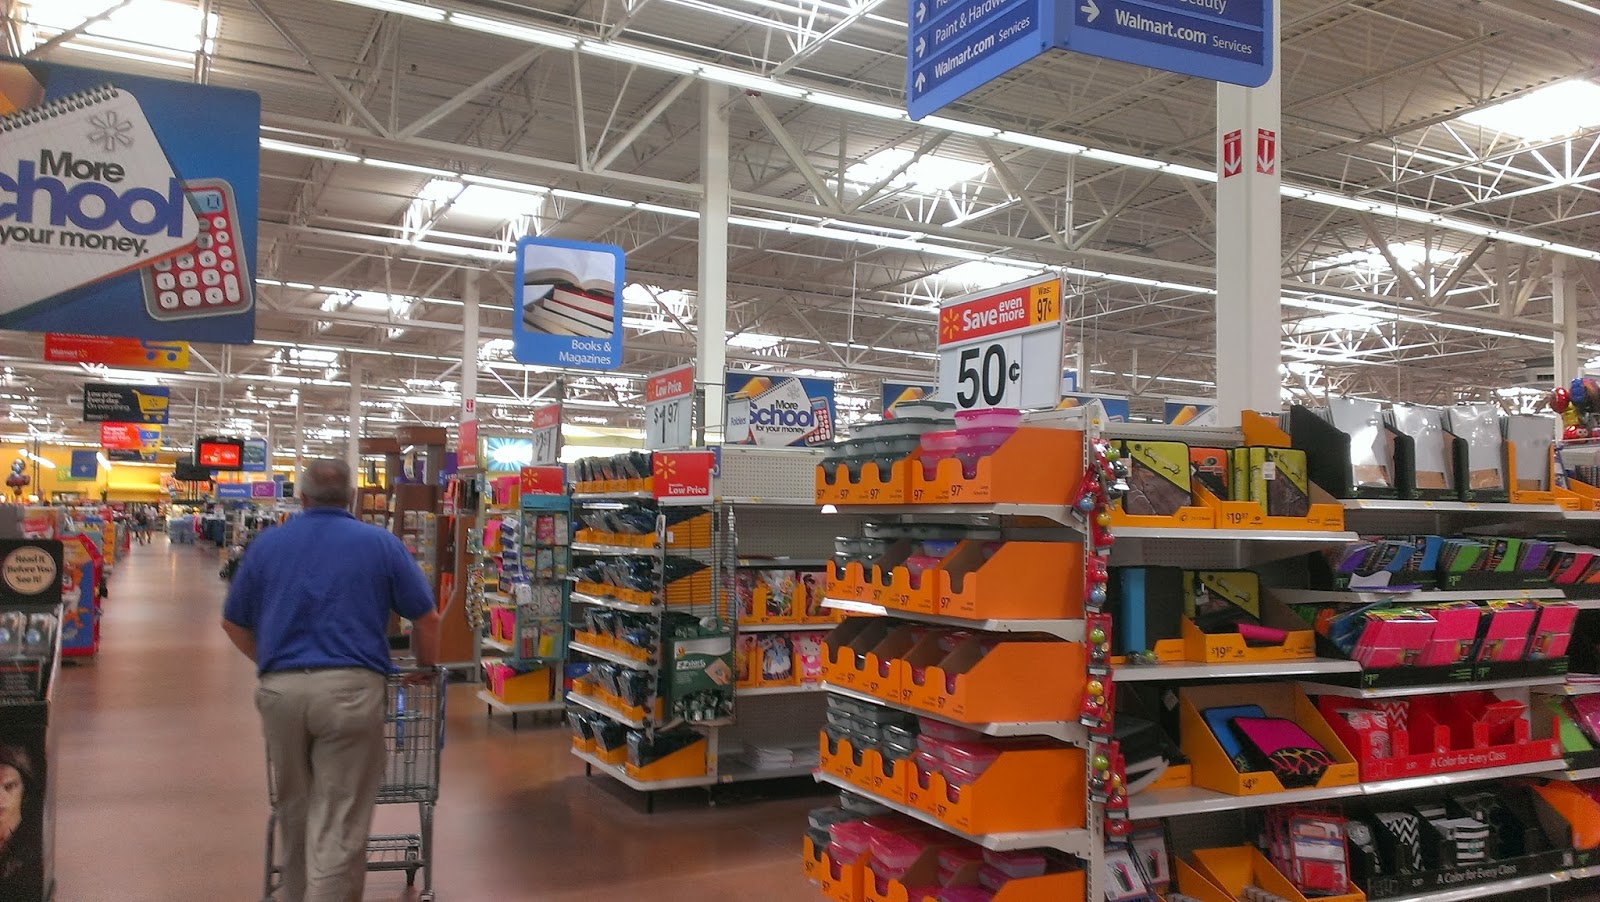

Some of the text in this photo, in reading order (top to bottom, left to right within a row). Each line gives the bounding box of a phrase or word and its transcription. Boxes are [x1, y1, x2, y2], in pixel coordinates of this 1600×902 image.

[1180, 0, 1227, 15] eauty
[935, 22, 958, 45] Paint
[960, 12, 967, 29] &
[1115, 9, 1252, 54] Walmart.com Services
[934, 16, 1030, 79] Walmart.com Services
[39, 149, 125, 183] More
[0, 224, 54, 245] your
[60, 230, 149, 257] money.
[962, 297, 1023, 332] Save even
[999, 308, 1025, 323] more
[571, 339, 612, 352] Books &
[559, 351, 611, 365] Magazines
[655, 384, 667, 397] Low
[667, 379, 682, 394] Price
[750, 401, 814, 427] School
[775, 400, 799, 410] More
[668, 486, 685, 495] Low
[686, 485, 707, 495] Price
[1430, 751, 1507, 768] A Color for Every Class
[1437, 873, 1444, 884] A
[1444, 872, 1465, 883] Color
[1465, 869, 1477, 880] for
[1477, 867, 1498, 879] Every
[1499, 864, 1517, 875] Class
